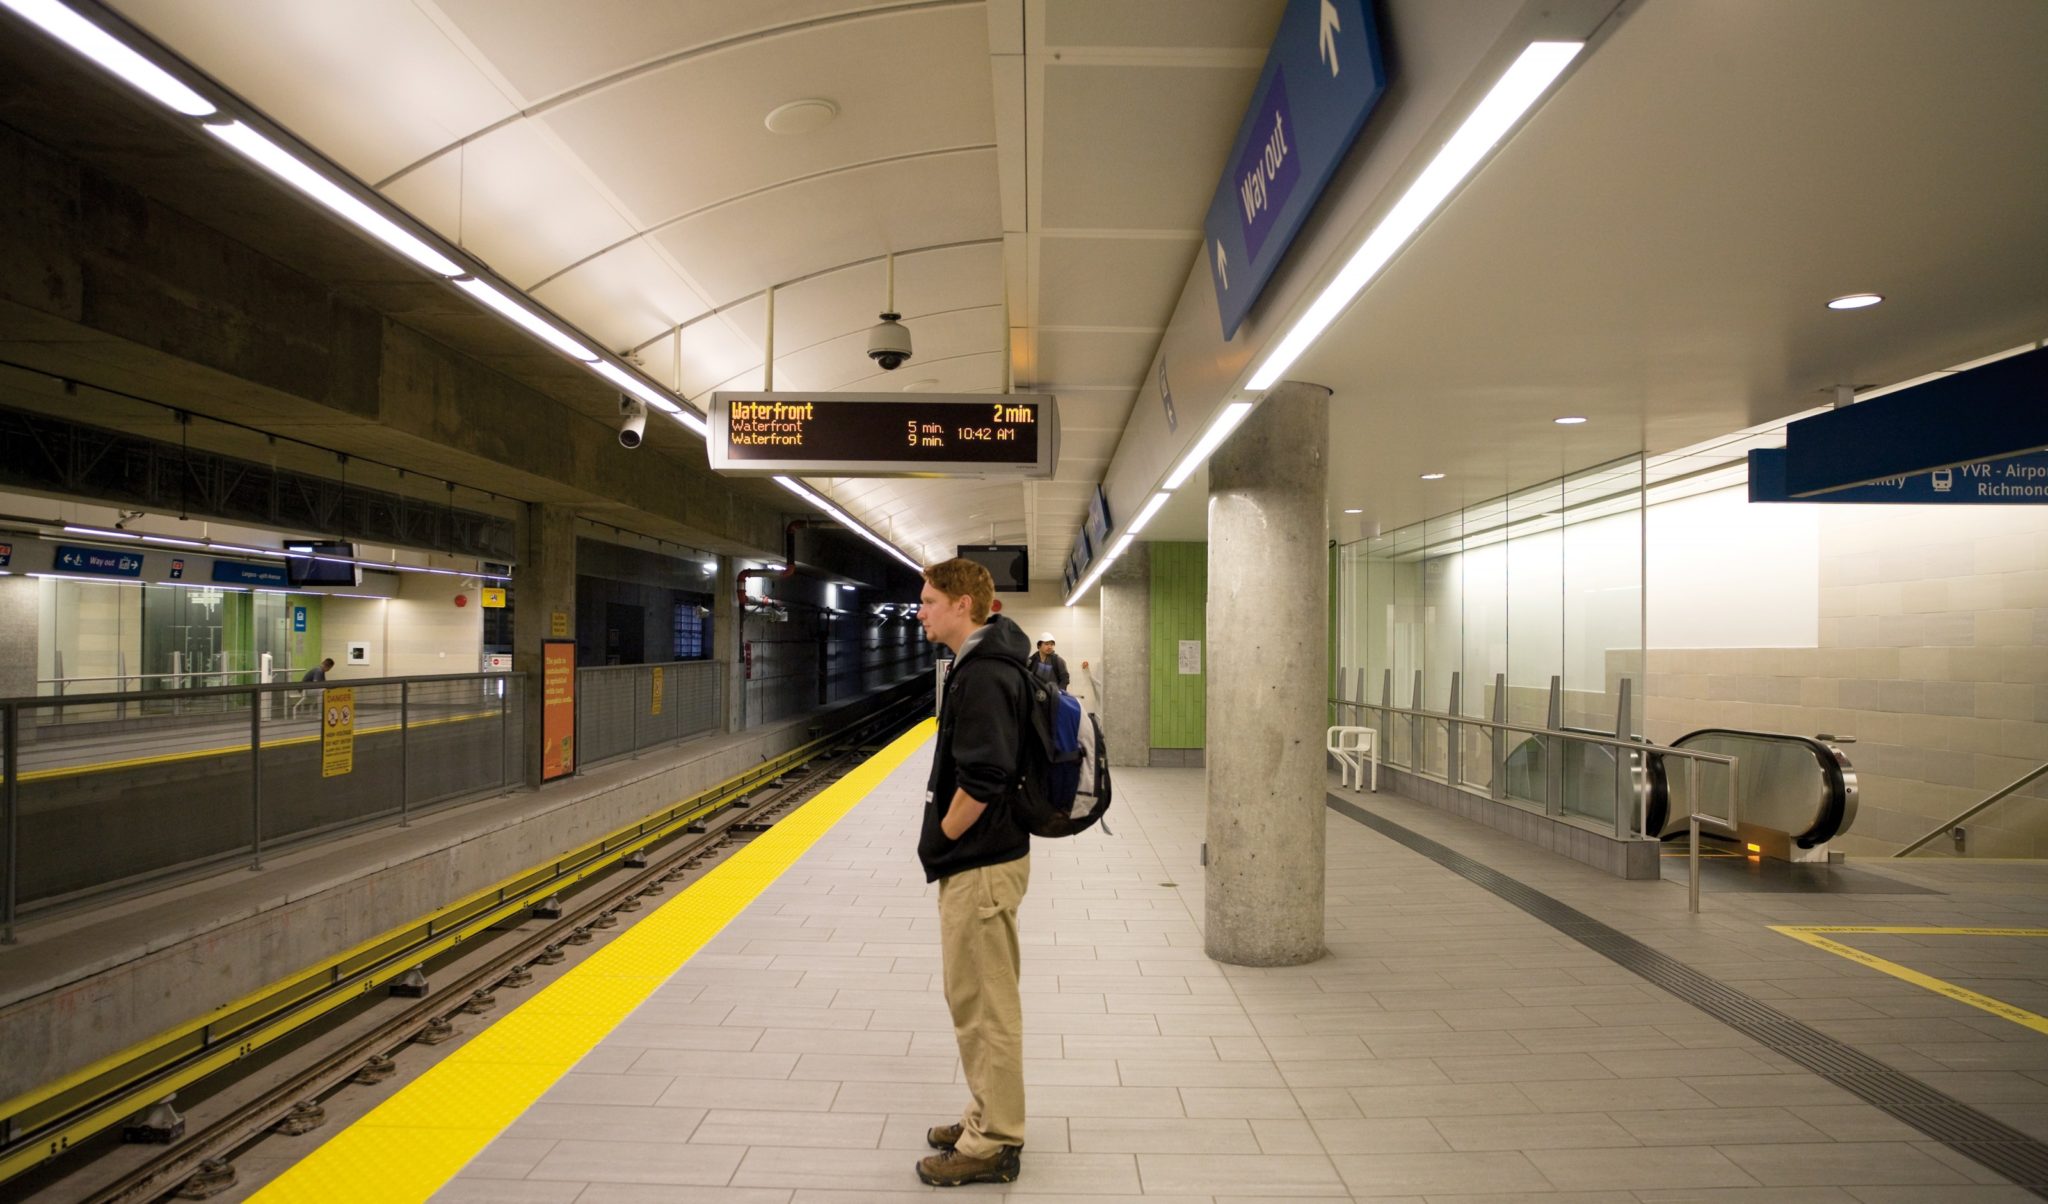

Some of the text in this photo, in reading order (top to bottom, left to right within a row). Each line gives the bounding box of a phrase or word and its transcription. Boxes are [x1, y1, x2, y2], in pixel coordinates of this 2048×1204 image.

[1241, 110, 1288, 225] Way out
[731, 401, 1035, 423] Waterfront 2 min.
[731, 419, 945, 434] Waterfront 5 min.
[957, 427, 1015, 441] 10:42 AM
[731, 432, 945, 447] Waterfront 9 min.
[1961, 463, 1991, 477] YVR
[2005, 463, 2048, 480] Airpo
[90, 556, 115, 568] Way out
